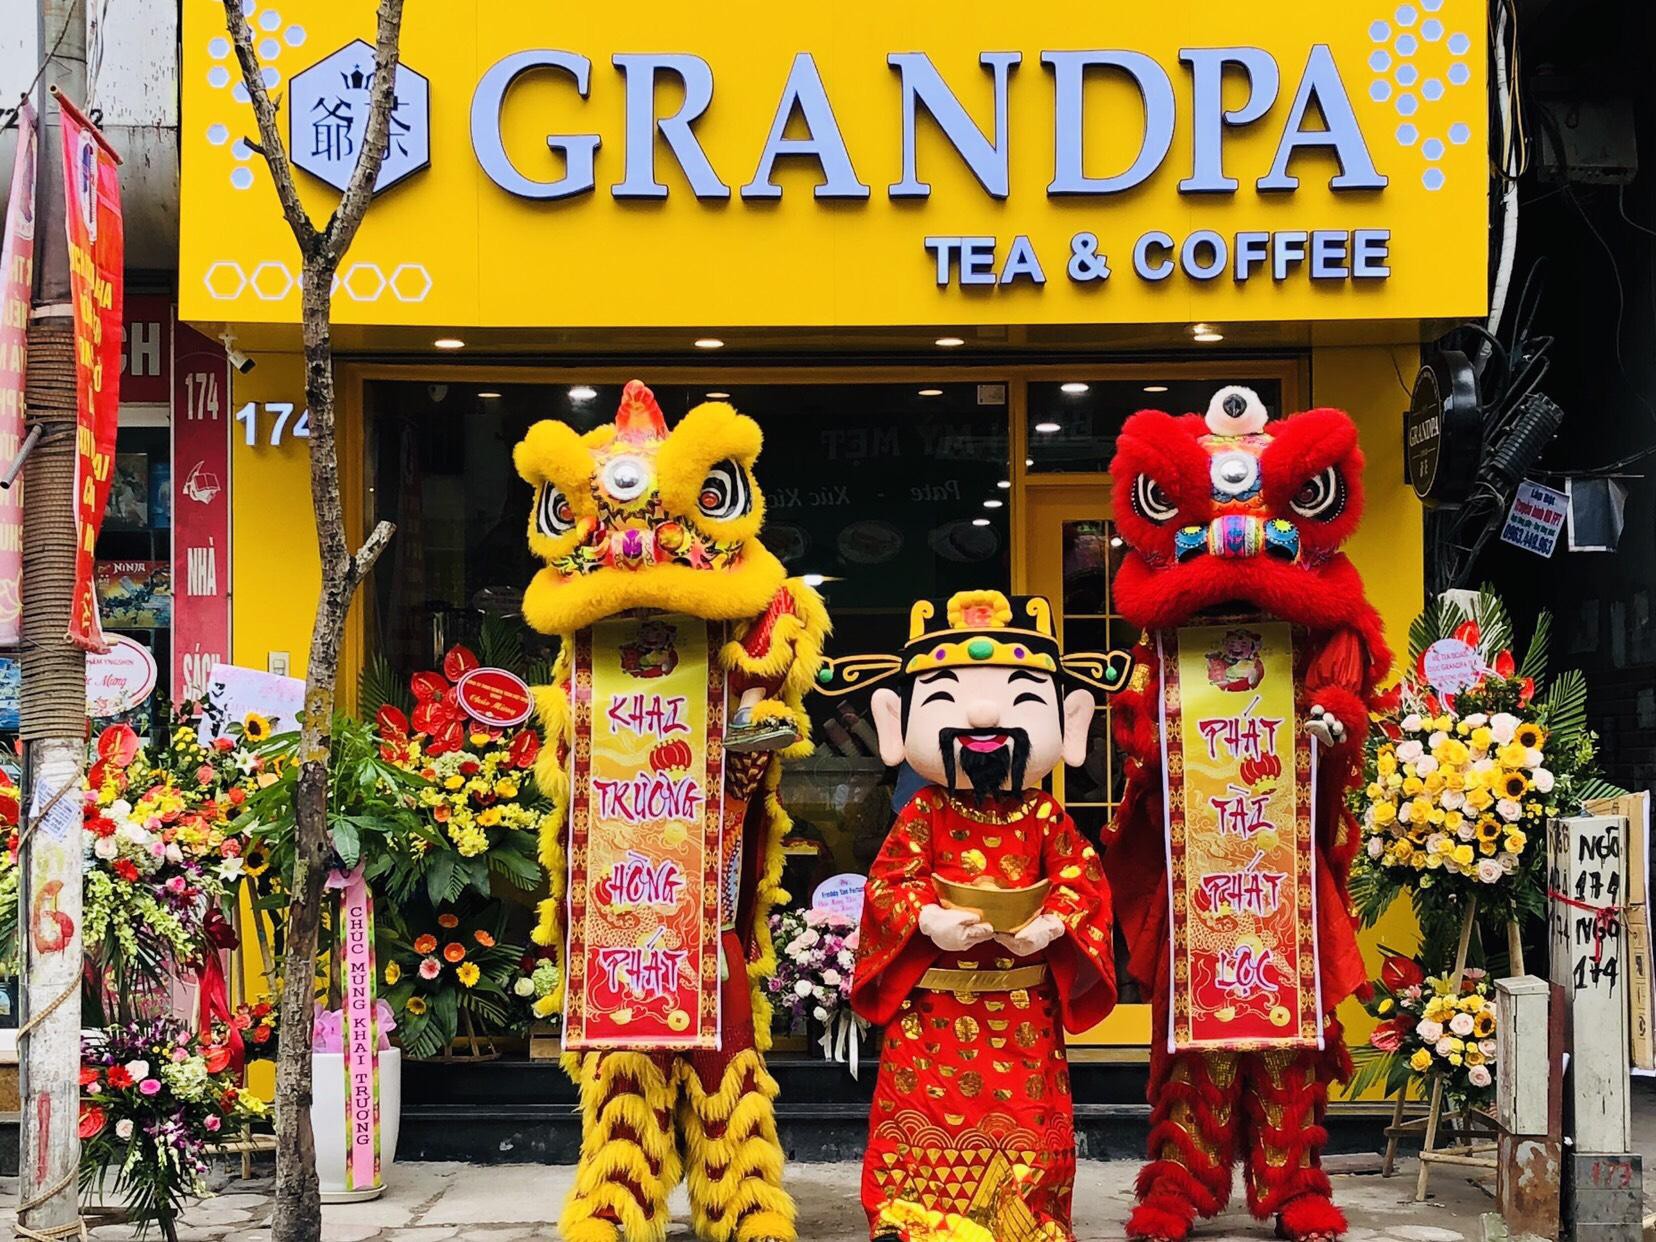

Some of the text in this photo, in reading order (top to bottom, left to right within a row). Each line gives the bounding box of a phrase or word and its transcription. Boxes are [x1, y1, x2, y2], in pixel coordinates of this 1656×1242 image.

[470, 43, 1389, 202] GRANDPA
[925, 229, 1391, 287] TEA & COFFEE
[121, 322, 161, 376] H
[185, 372, 218, 421] 174
[1409, 415, 1440, 447] GRANDPA
[187, 537, 217, 597] NHÀ
[183, 643, 221, 701] SÁC
[608, 694, 689, 738] KHAI
[1199, 696, 1283, 761] PHÁT
[1211, 785, 1275, 839] TÀI
[608, 852, 683, 904] HỒNG
[1203, 852, 1287, 916] PHÁT
[350, 907, 364, 954] CHÚC
[602, 928, 687, 995] PHÁT
[1217, 945, 1278, 996] LỘC
[353, 1018, 368, 1065] KHAI
[355, 1073, 371, 1145] TRƯƠNG
